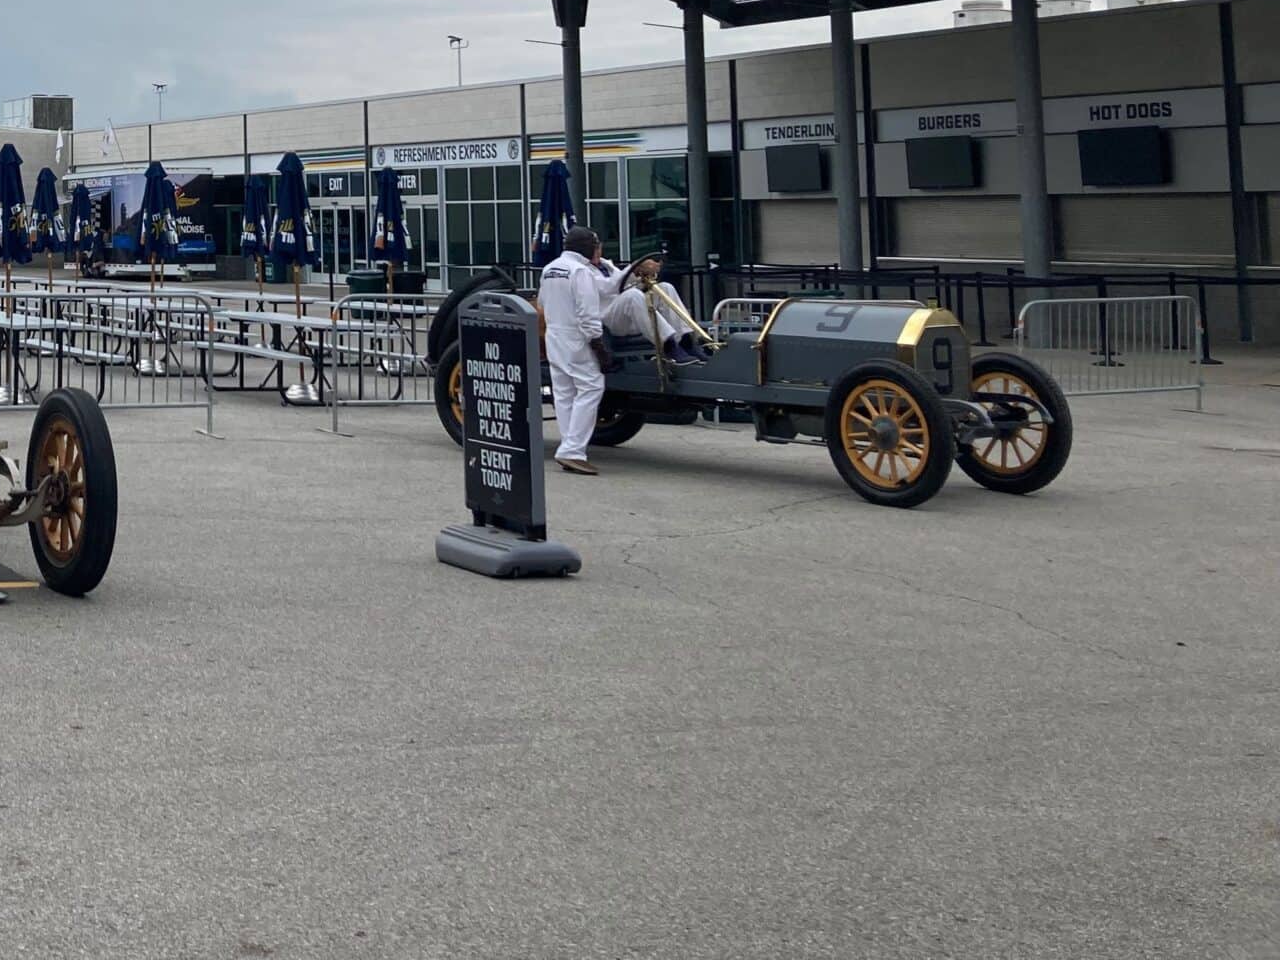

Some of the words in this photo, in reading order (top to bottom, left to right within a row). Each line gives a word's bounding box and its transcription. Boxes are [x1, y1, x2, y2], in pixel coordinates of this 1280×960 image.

[918, 113, 982, 131] BURGERS
[1089, 104, 1122, 121] HOT
[1126, 102, 1172, 120] DOGS
[393, 145, 457, 163] REFRESHMENTS
[459, 143, 498, 160] EXPRESS
[329, 177, 343, 191] EXIT
[397, 175, 416, 189] NTER
[816, 304, 863, 333] 9
[484, 342, 500, 360] NO
[466, 360, 504, 380] DRIVING
[507, 365, 522, 383] OR
[932, 337, 953, 394] 9
[473, 380, 515, 402] PARKING
[477, 400, 491, 418] ON
[493, 402, 513, 421] THE
[479, 419, 512, 441] PLAZA
[480, 448, 512, 471] EVENT
[481, 468, 513, 491] TODAY
